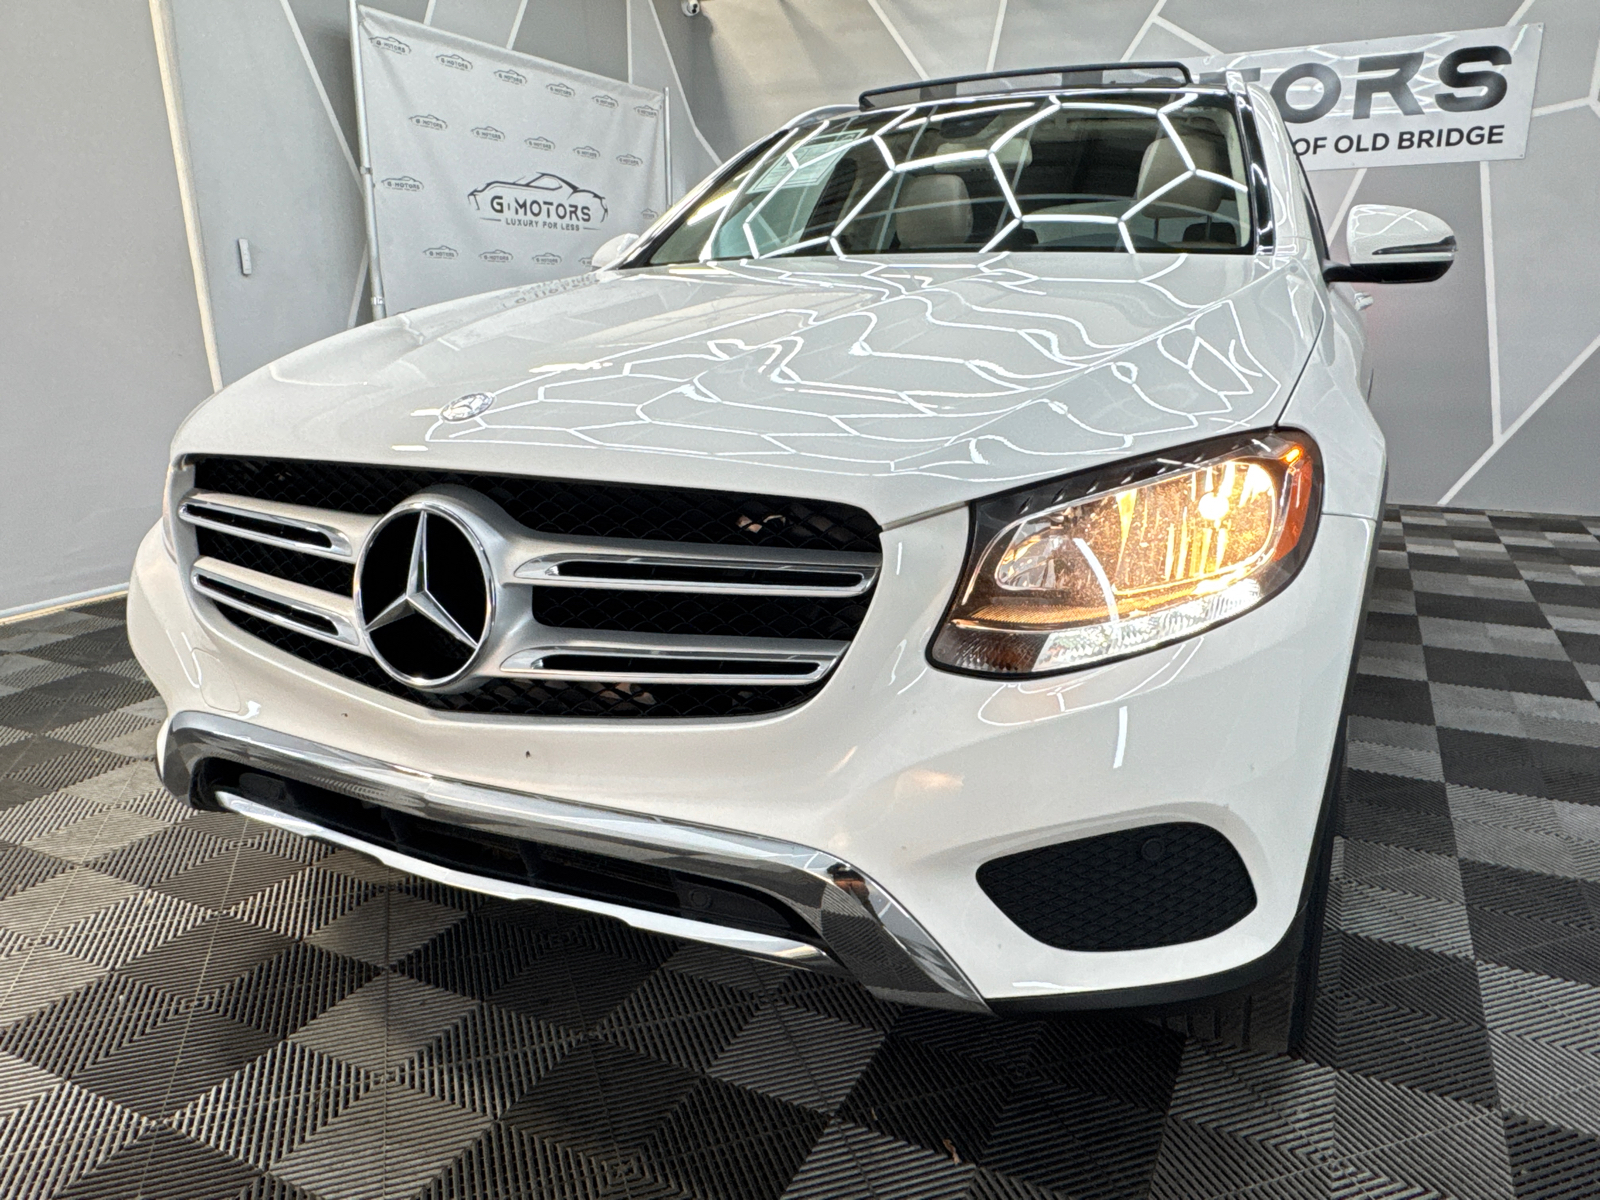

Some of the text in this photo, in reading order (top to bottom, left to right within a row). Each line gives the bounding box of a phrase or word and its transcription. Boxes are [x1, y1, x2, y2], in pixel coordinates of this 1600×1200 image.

[1293, 125, 1505, 156] OF OLD BRIDGE
[394, 182, 420, 190] MOTORS
[490, 195, 592, 222] G MOTORS
[505, 218, 580, 231] LUXURY FOR LESS
